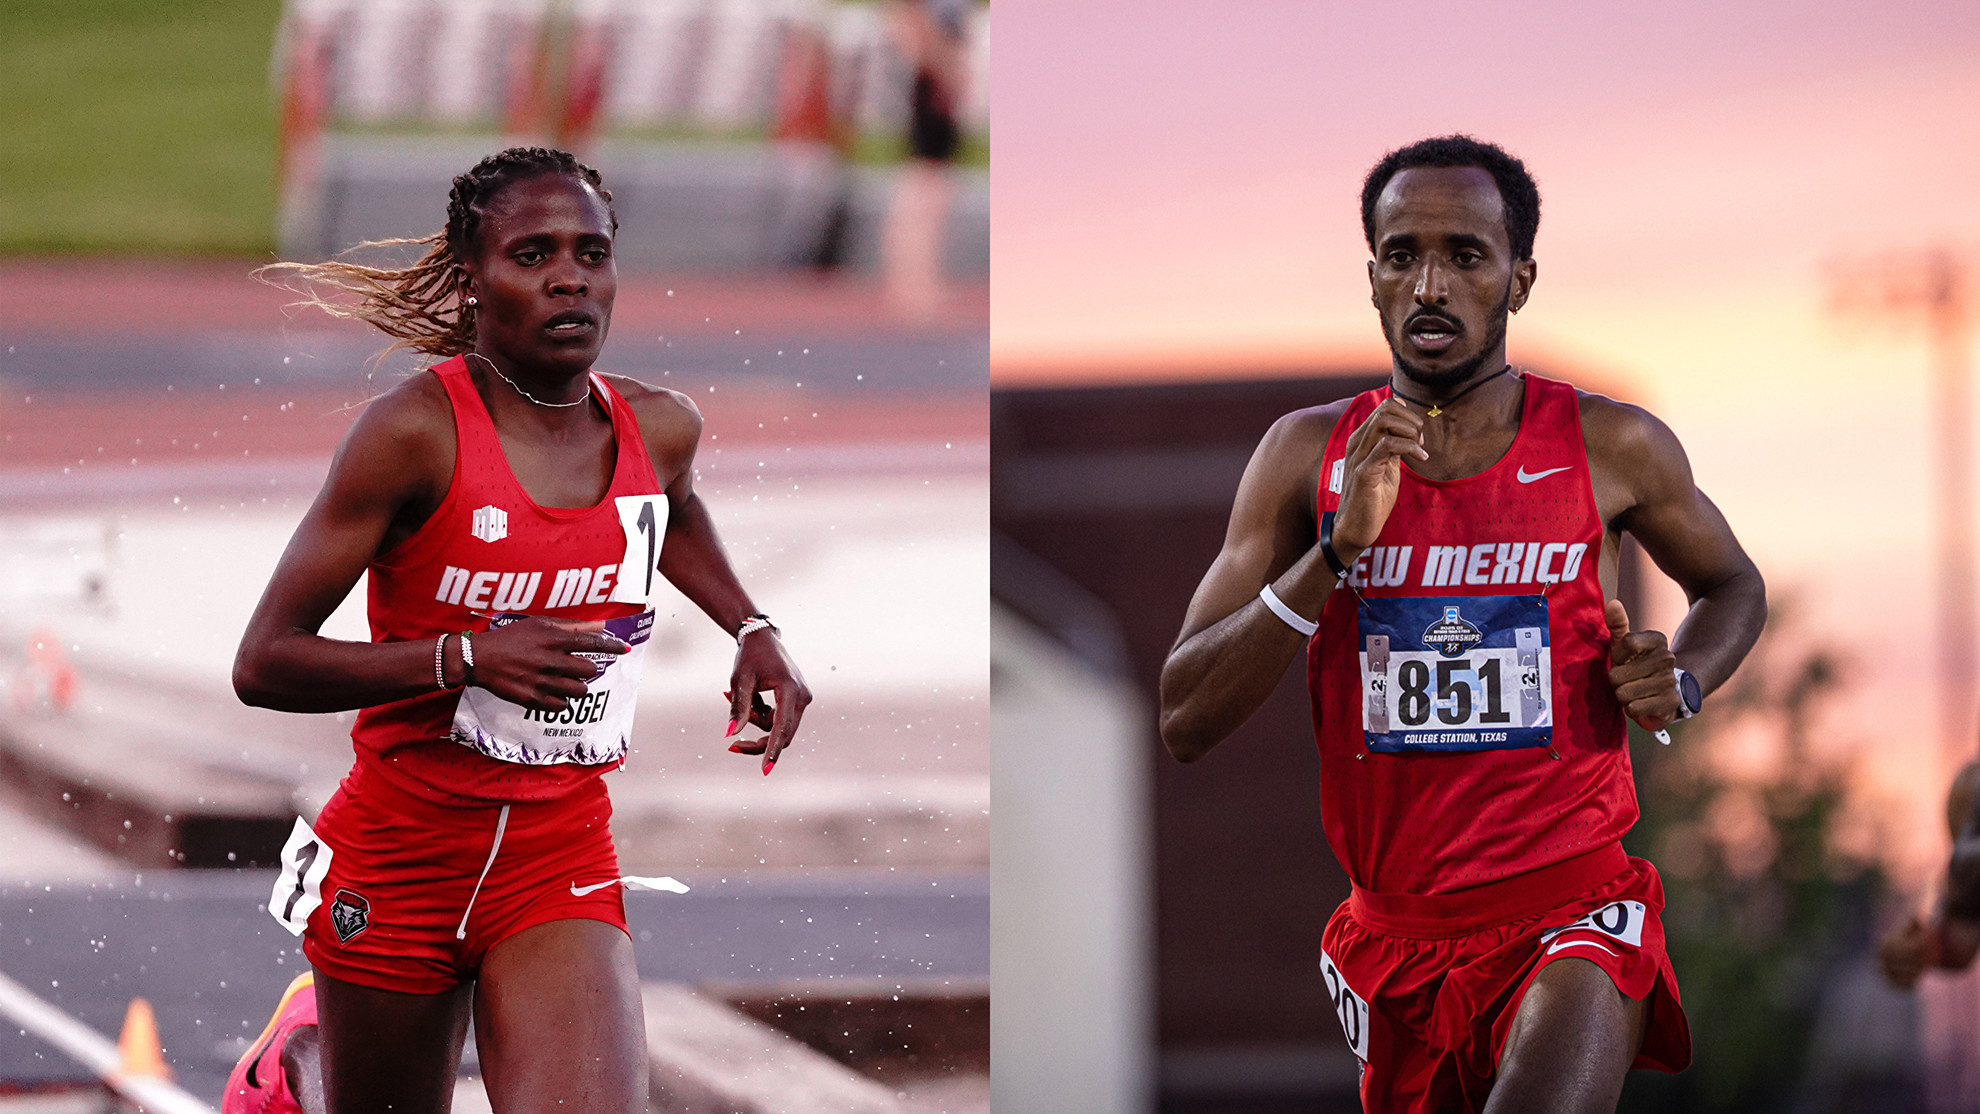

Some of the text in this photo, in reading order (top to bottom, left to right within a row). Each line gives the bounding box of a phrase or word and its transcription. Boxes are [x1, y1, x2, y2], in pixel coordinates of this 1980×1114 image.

[636, 501, 656, 597] 1
[1335, 542, 1588, 589] EW MEXICO
[435, 563, 622, 611] NEW ME
[1424, 634, 1481, 643] CHAMPIONSHIPS
[1398, 658, 1510, 726] 851
[1522, 673, 1535, 686] 2
[543, 727, 583, 737] NEW MEXICO
[1404, 732, 1508, 744] COLLEGE STATION, TEXAS
[283, 839, 319, 923] 1
[337, 891, 368, 910] LOBOS
